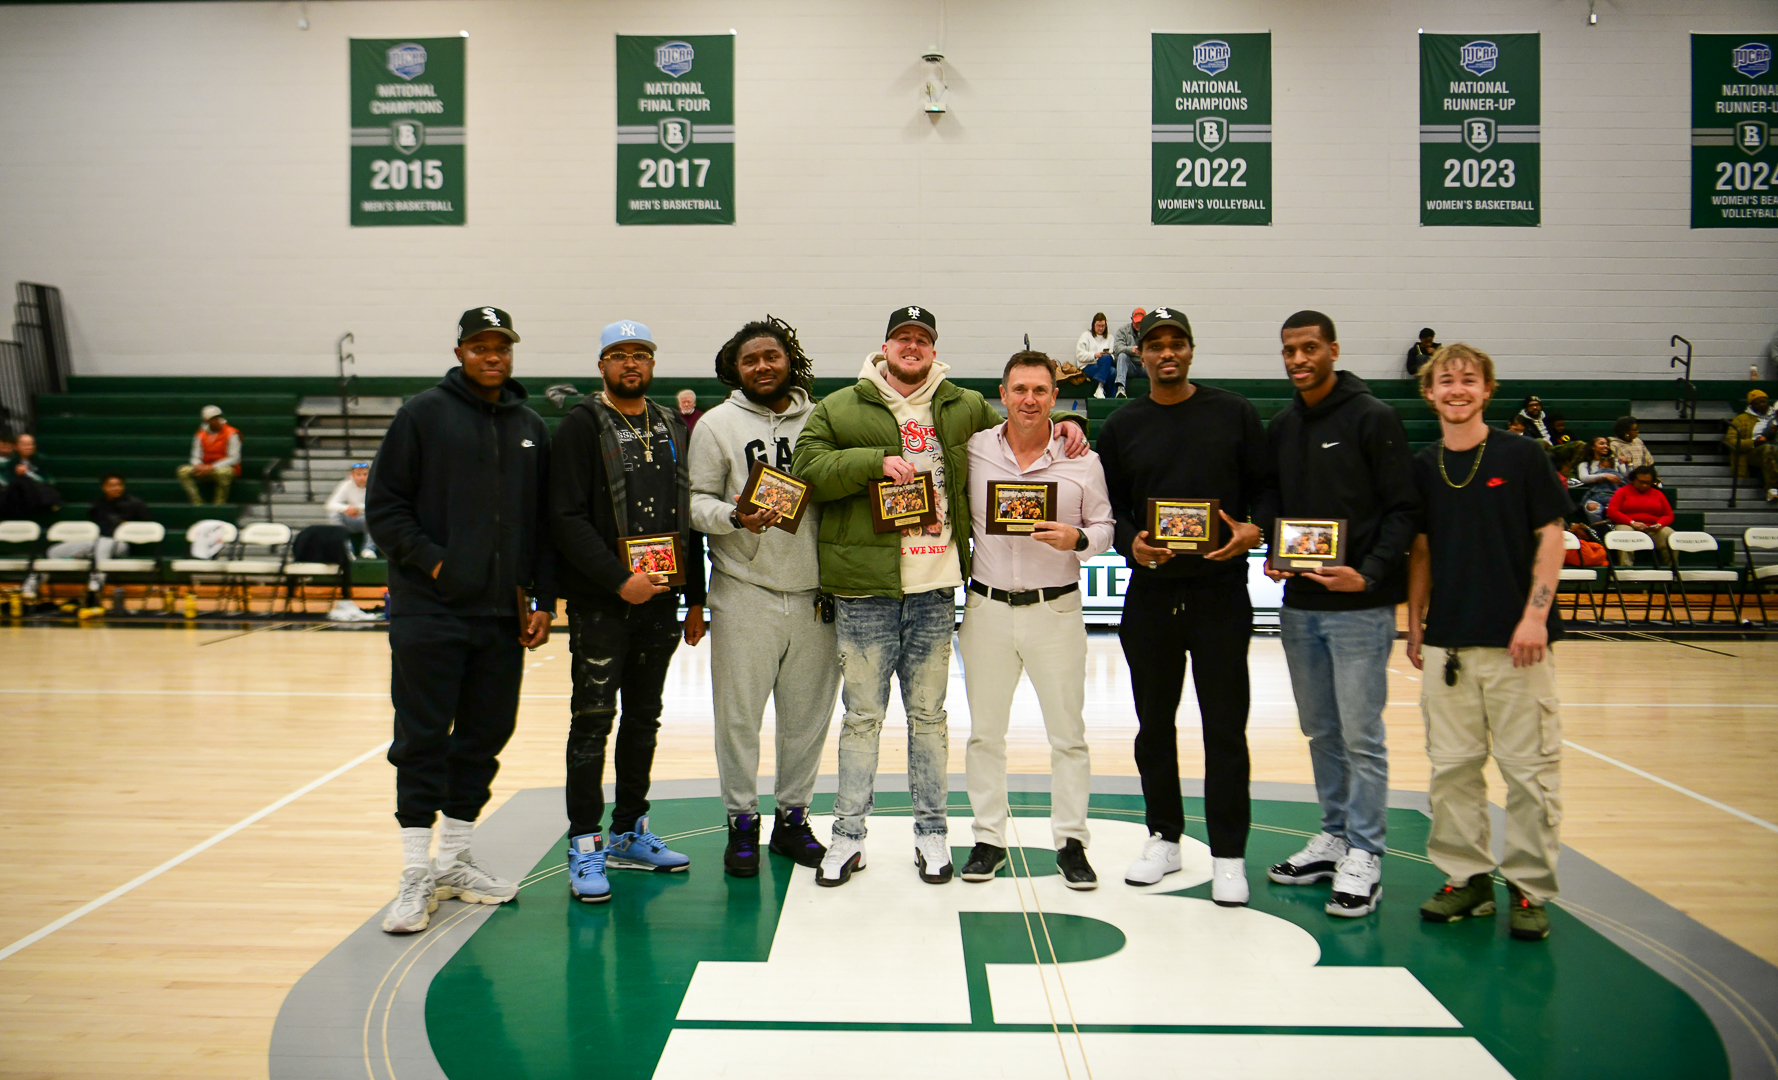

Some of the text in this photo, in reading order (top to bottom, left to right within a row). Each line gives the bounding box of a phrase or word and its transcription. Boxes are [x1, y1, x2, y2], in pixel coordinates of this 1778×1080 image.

[656, 47, 695, 68] NJCAA
[1193, 45, 1230, 66] NJCAA
[1460, 46, 1498, 66] NJCAA
[1732, 48, 1771, 68] NJCAA
[376, 83, 437, 98] NATIONAL
[644, 81, 705, 95] NATIONAL
[1182, 80, 1242, 94] NATIONAL
[1450, 81, 1509, 94] NATIONAL
[369, 99, 444, 115] CHAMPIONS
[638, 98, 711, 112] FINAL FOUR
[1175, 97, 1248, 111] CHAMPIONS
[1443, 98, 1516, 111] RUNNER-UP
[370, 159, 444, 190] 2015
[638, 158, 711, 189] 2017
[1176, 157, 1247, 187] 2022
[1443, 158, 1516, 188] 2023
[362, 200, 454, 212] MEN'S BASKETBALL
[630, 199, 722, 210] MEN'S BASKETBALL
[1157, 199, 1266, 210] WOMEN'S VOLLEYBALL
[1426, 200, 1534, 211] WOMEN'S BASKETBALL
[1711, 195, 1759, 206] WOMEN'S
[621, 323, 636, 337] NY
[909, 546, 926, 555] WE
